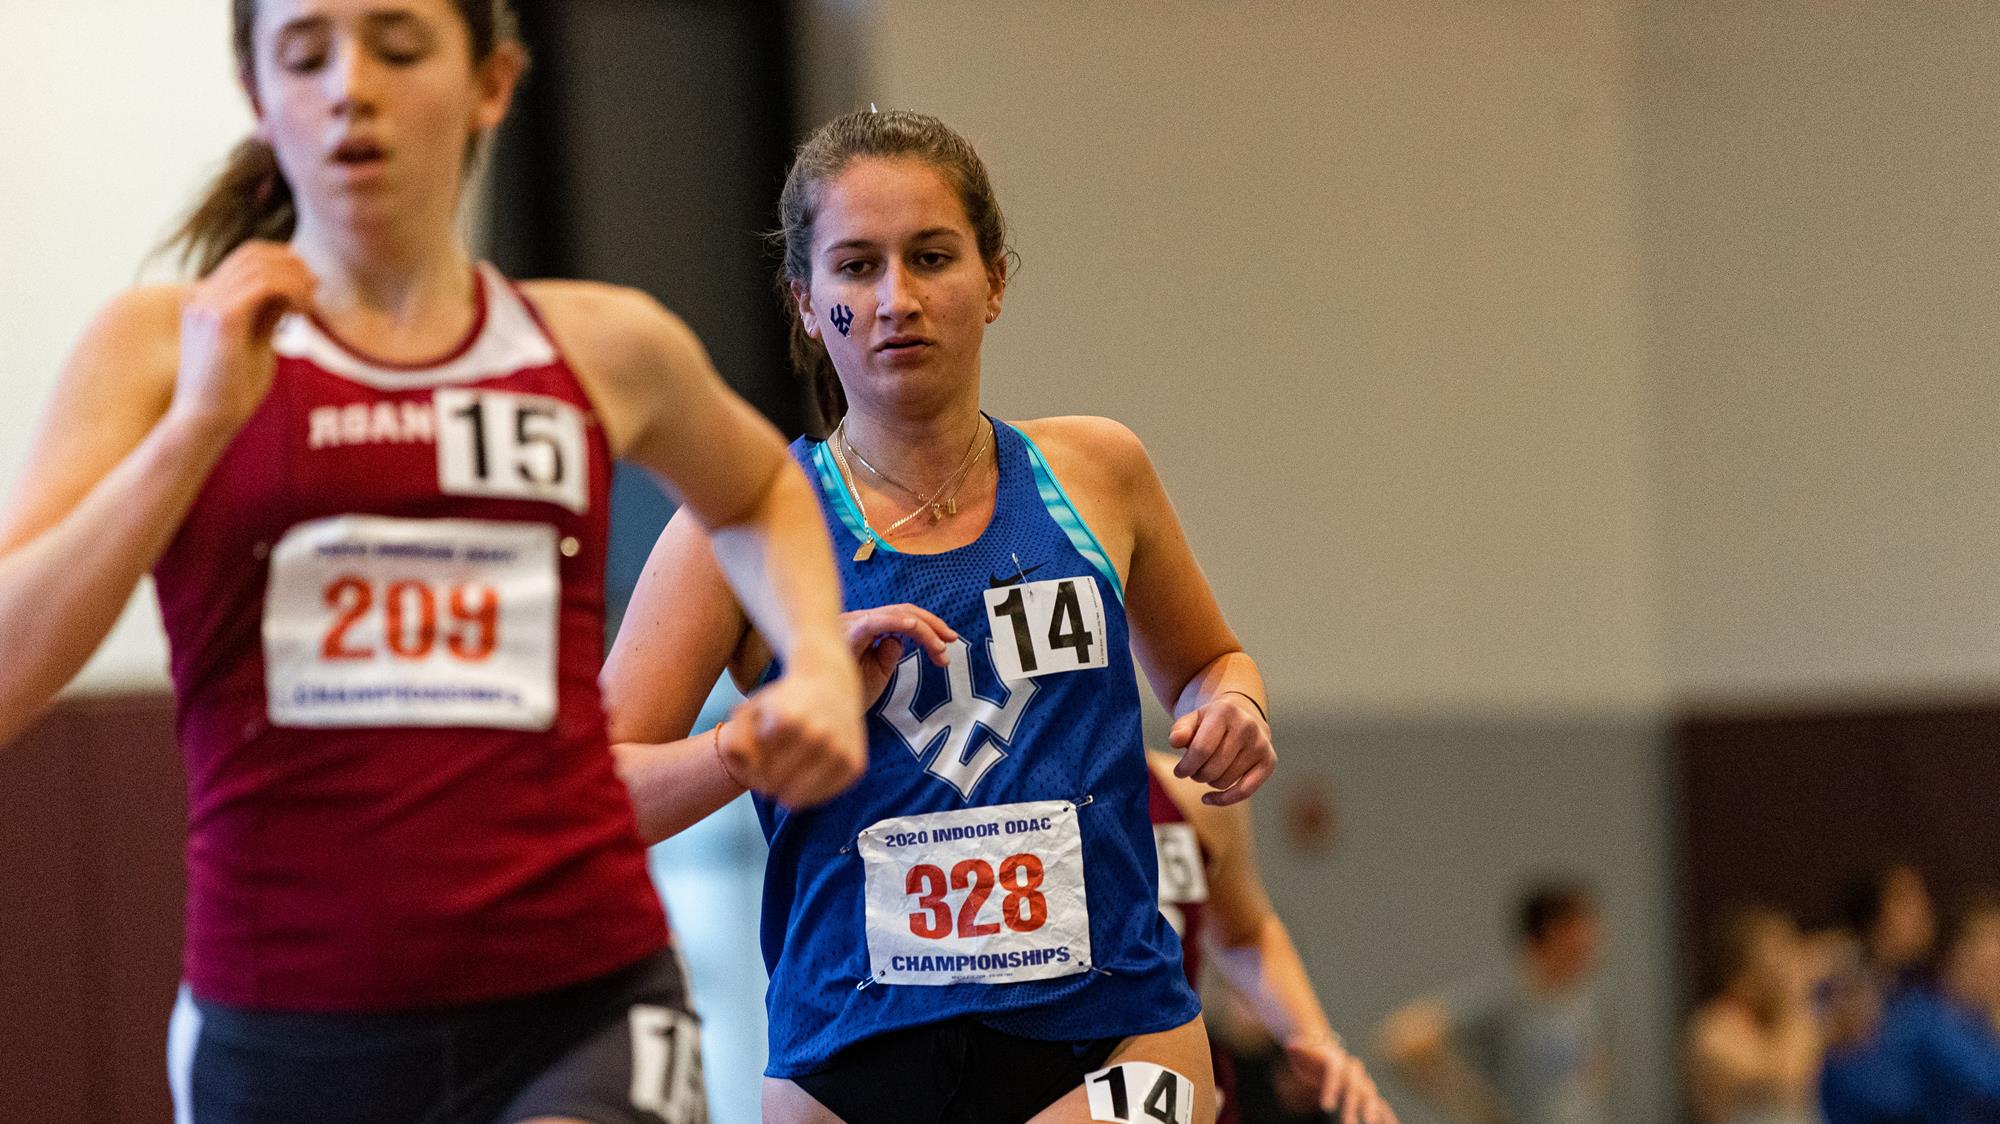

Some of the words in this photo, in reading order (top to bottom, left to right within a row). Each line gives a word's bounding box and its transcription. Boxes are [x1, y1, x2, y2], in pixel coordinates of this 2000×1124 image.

[452, 400, 566, 486] 15
[320, 575, 498, 664] 209
[993, 580, 1094, 673] 14
[885, 832, 928, 848] 2020
[932, 822, 1000, 843] INDOOR
[1004, 817, 1052, 835] ODAC
[905, 853, 1048, 940] 328
[891, 946, 1071, 972] CHAMPIONSHIPS
[1093, 1065, 1180, 1124] 14
